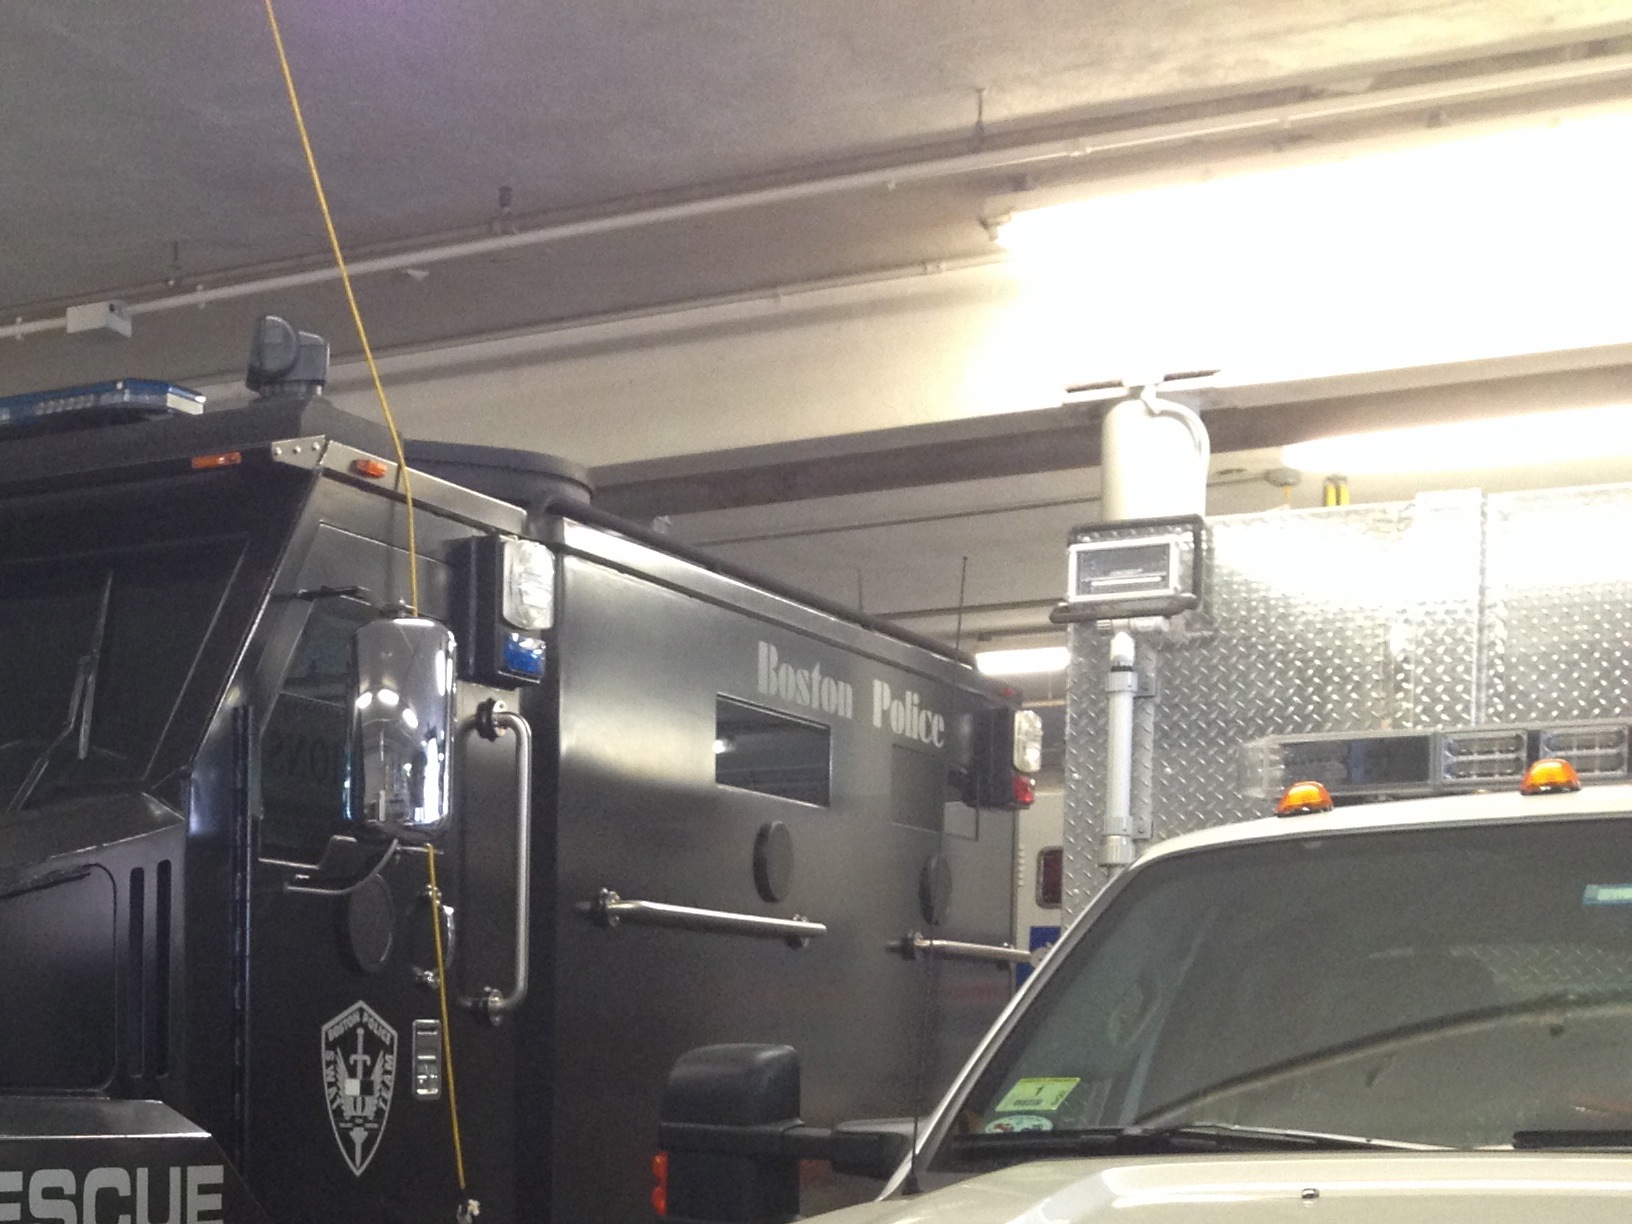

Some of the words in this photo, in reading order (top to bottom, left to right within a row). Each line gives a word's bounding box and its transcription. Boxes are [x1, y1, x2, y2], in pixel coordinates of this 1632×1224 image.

[757, 640, 854, 720] Boston
[872, 678, 946, 749] Police
[327, 1009, 361, 1042] BOSTON
[362, 1010, 392, 1046] POLICE
